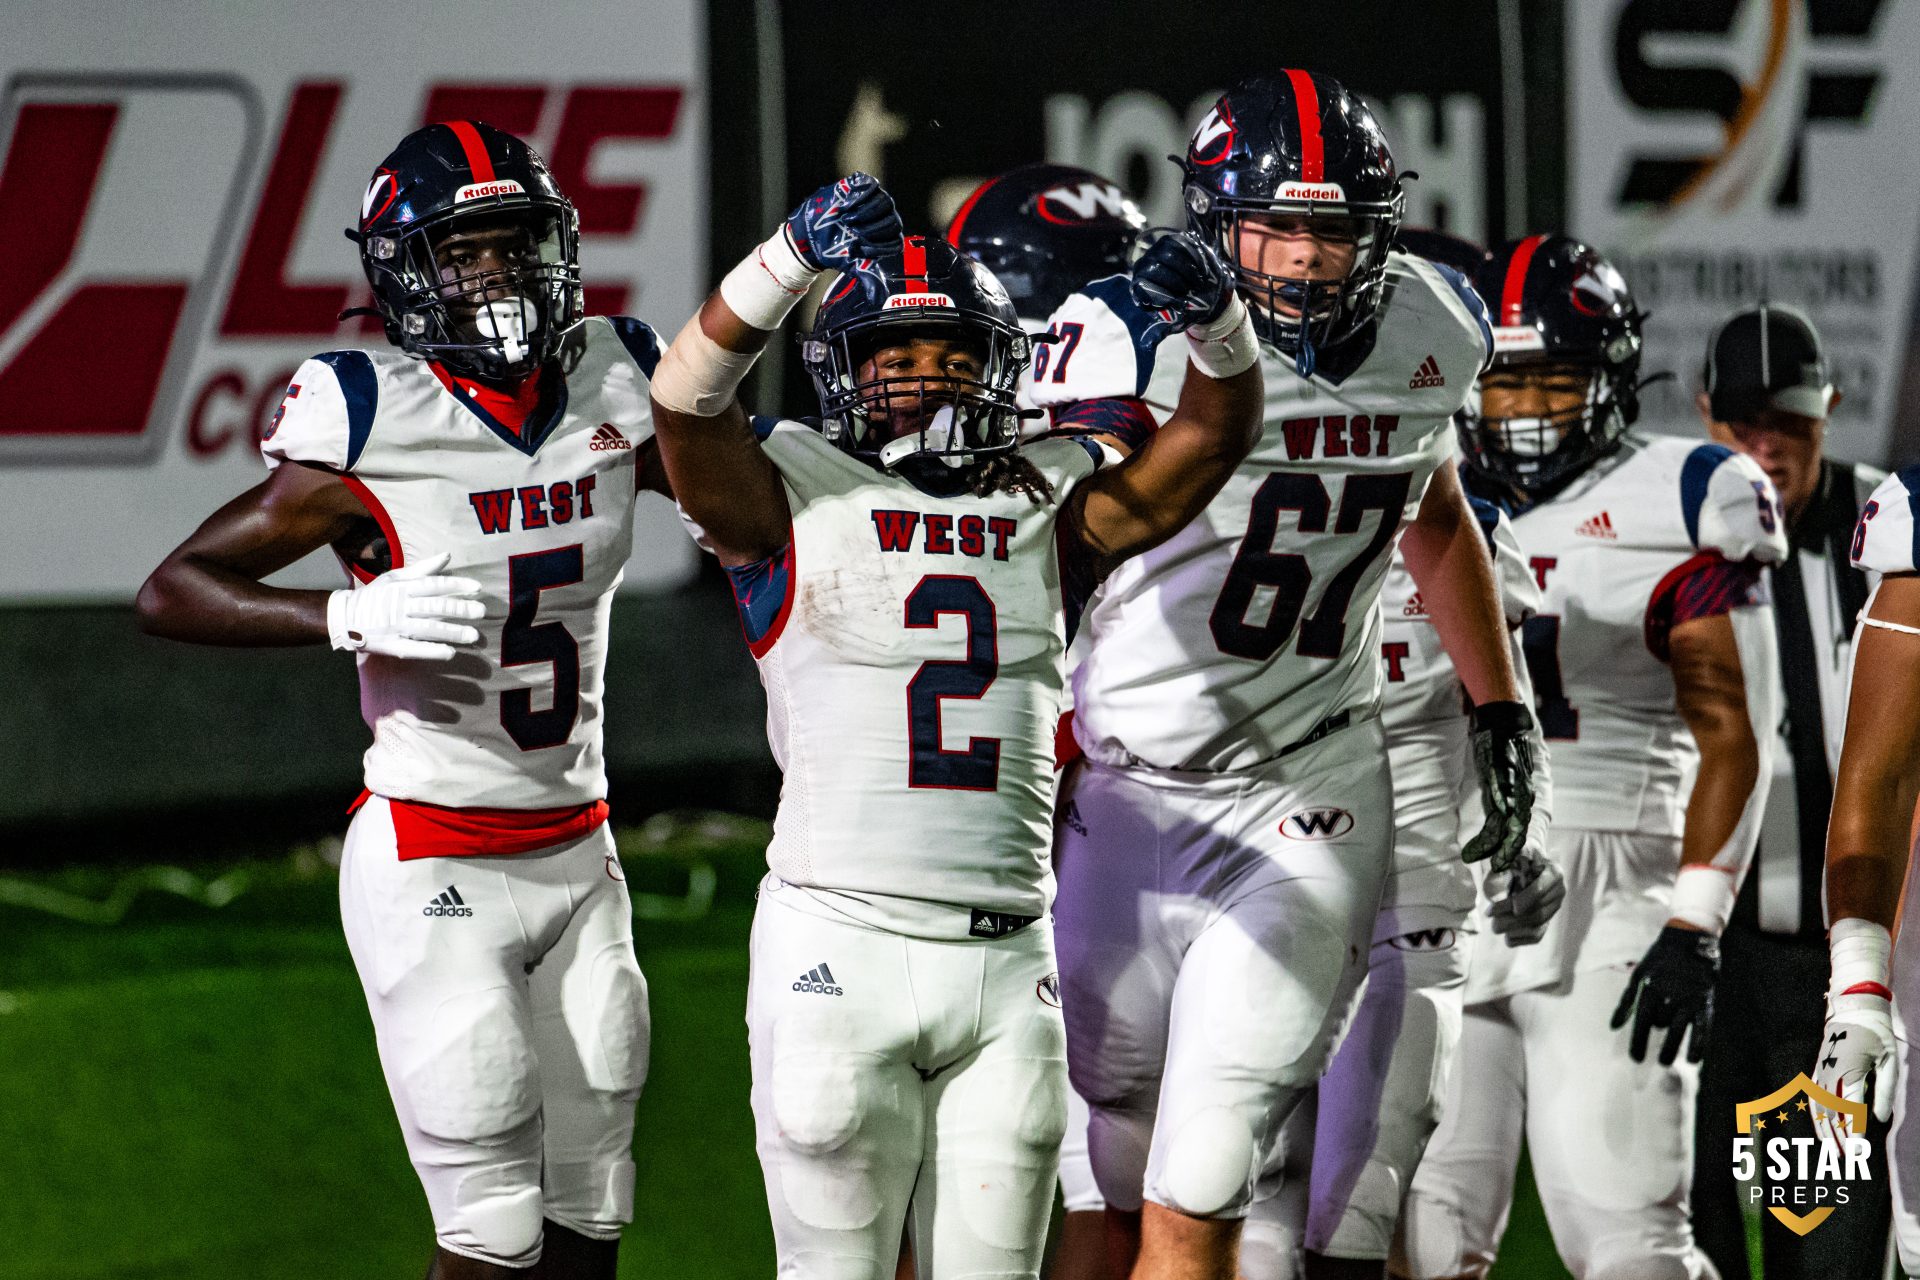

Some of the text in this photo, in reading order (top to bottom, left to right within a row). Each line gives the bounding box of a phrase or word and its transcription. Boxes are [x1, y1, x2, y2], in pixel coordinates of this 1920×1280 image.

[463, 184, 518, 199] Riddell
[1285, 187, 1339, 200] Riddell
[891, 296, 948, 308] Riddell
[1409, 375, 1445, 389] adidas
[589, 438, 632, 451] adidas
[1281, 415, 1400, 461] WEST
[469, 474, 597, 536] WEST
[871, 509, 1018, 562] WEST
[1208, 471, 1413, 662] 67
[500, 543, 584, 752] 5
[904, 574, 1001, 792] 2
[1289, 809, 1348, 837] W
[422, 904, 474, 918] adidas
[792, 980, 844, 997] adidas
